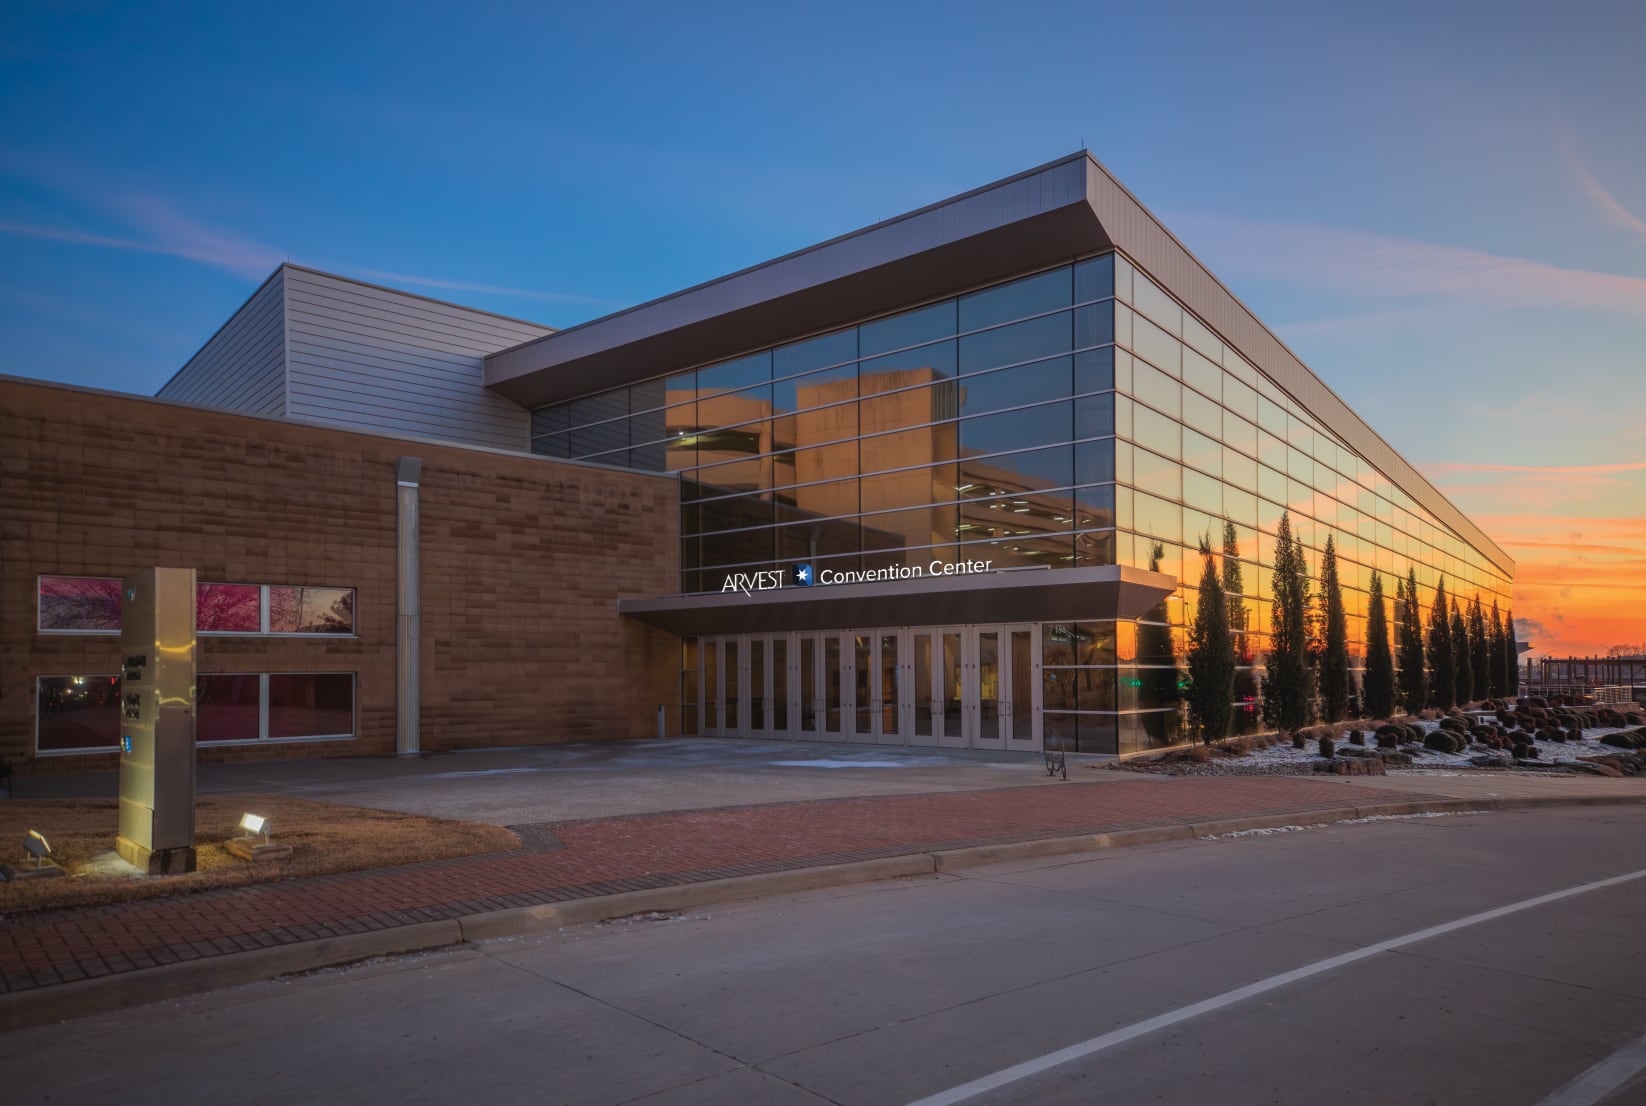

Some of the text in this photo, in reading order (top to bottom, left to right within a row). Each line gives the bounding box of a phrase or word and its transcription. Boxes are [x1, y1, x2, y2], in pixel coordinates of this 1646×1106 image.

[721, 559, 993, 597] ARVEST Convention Center
